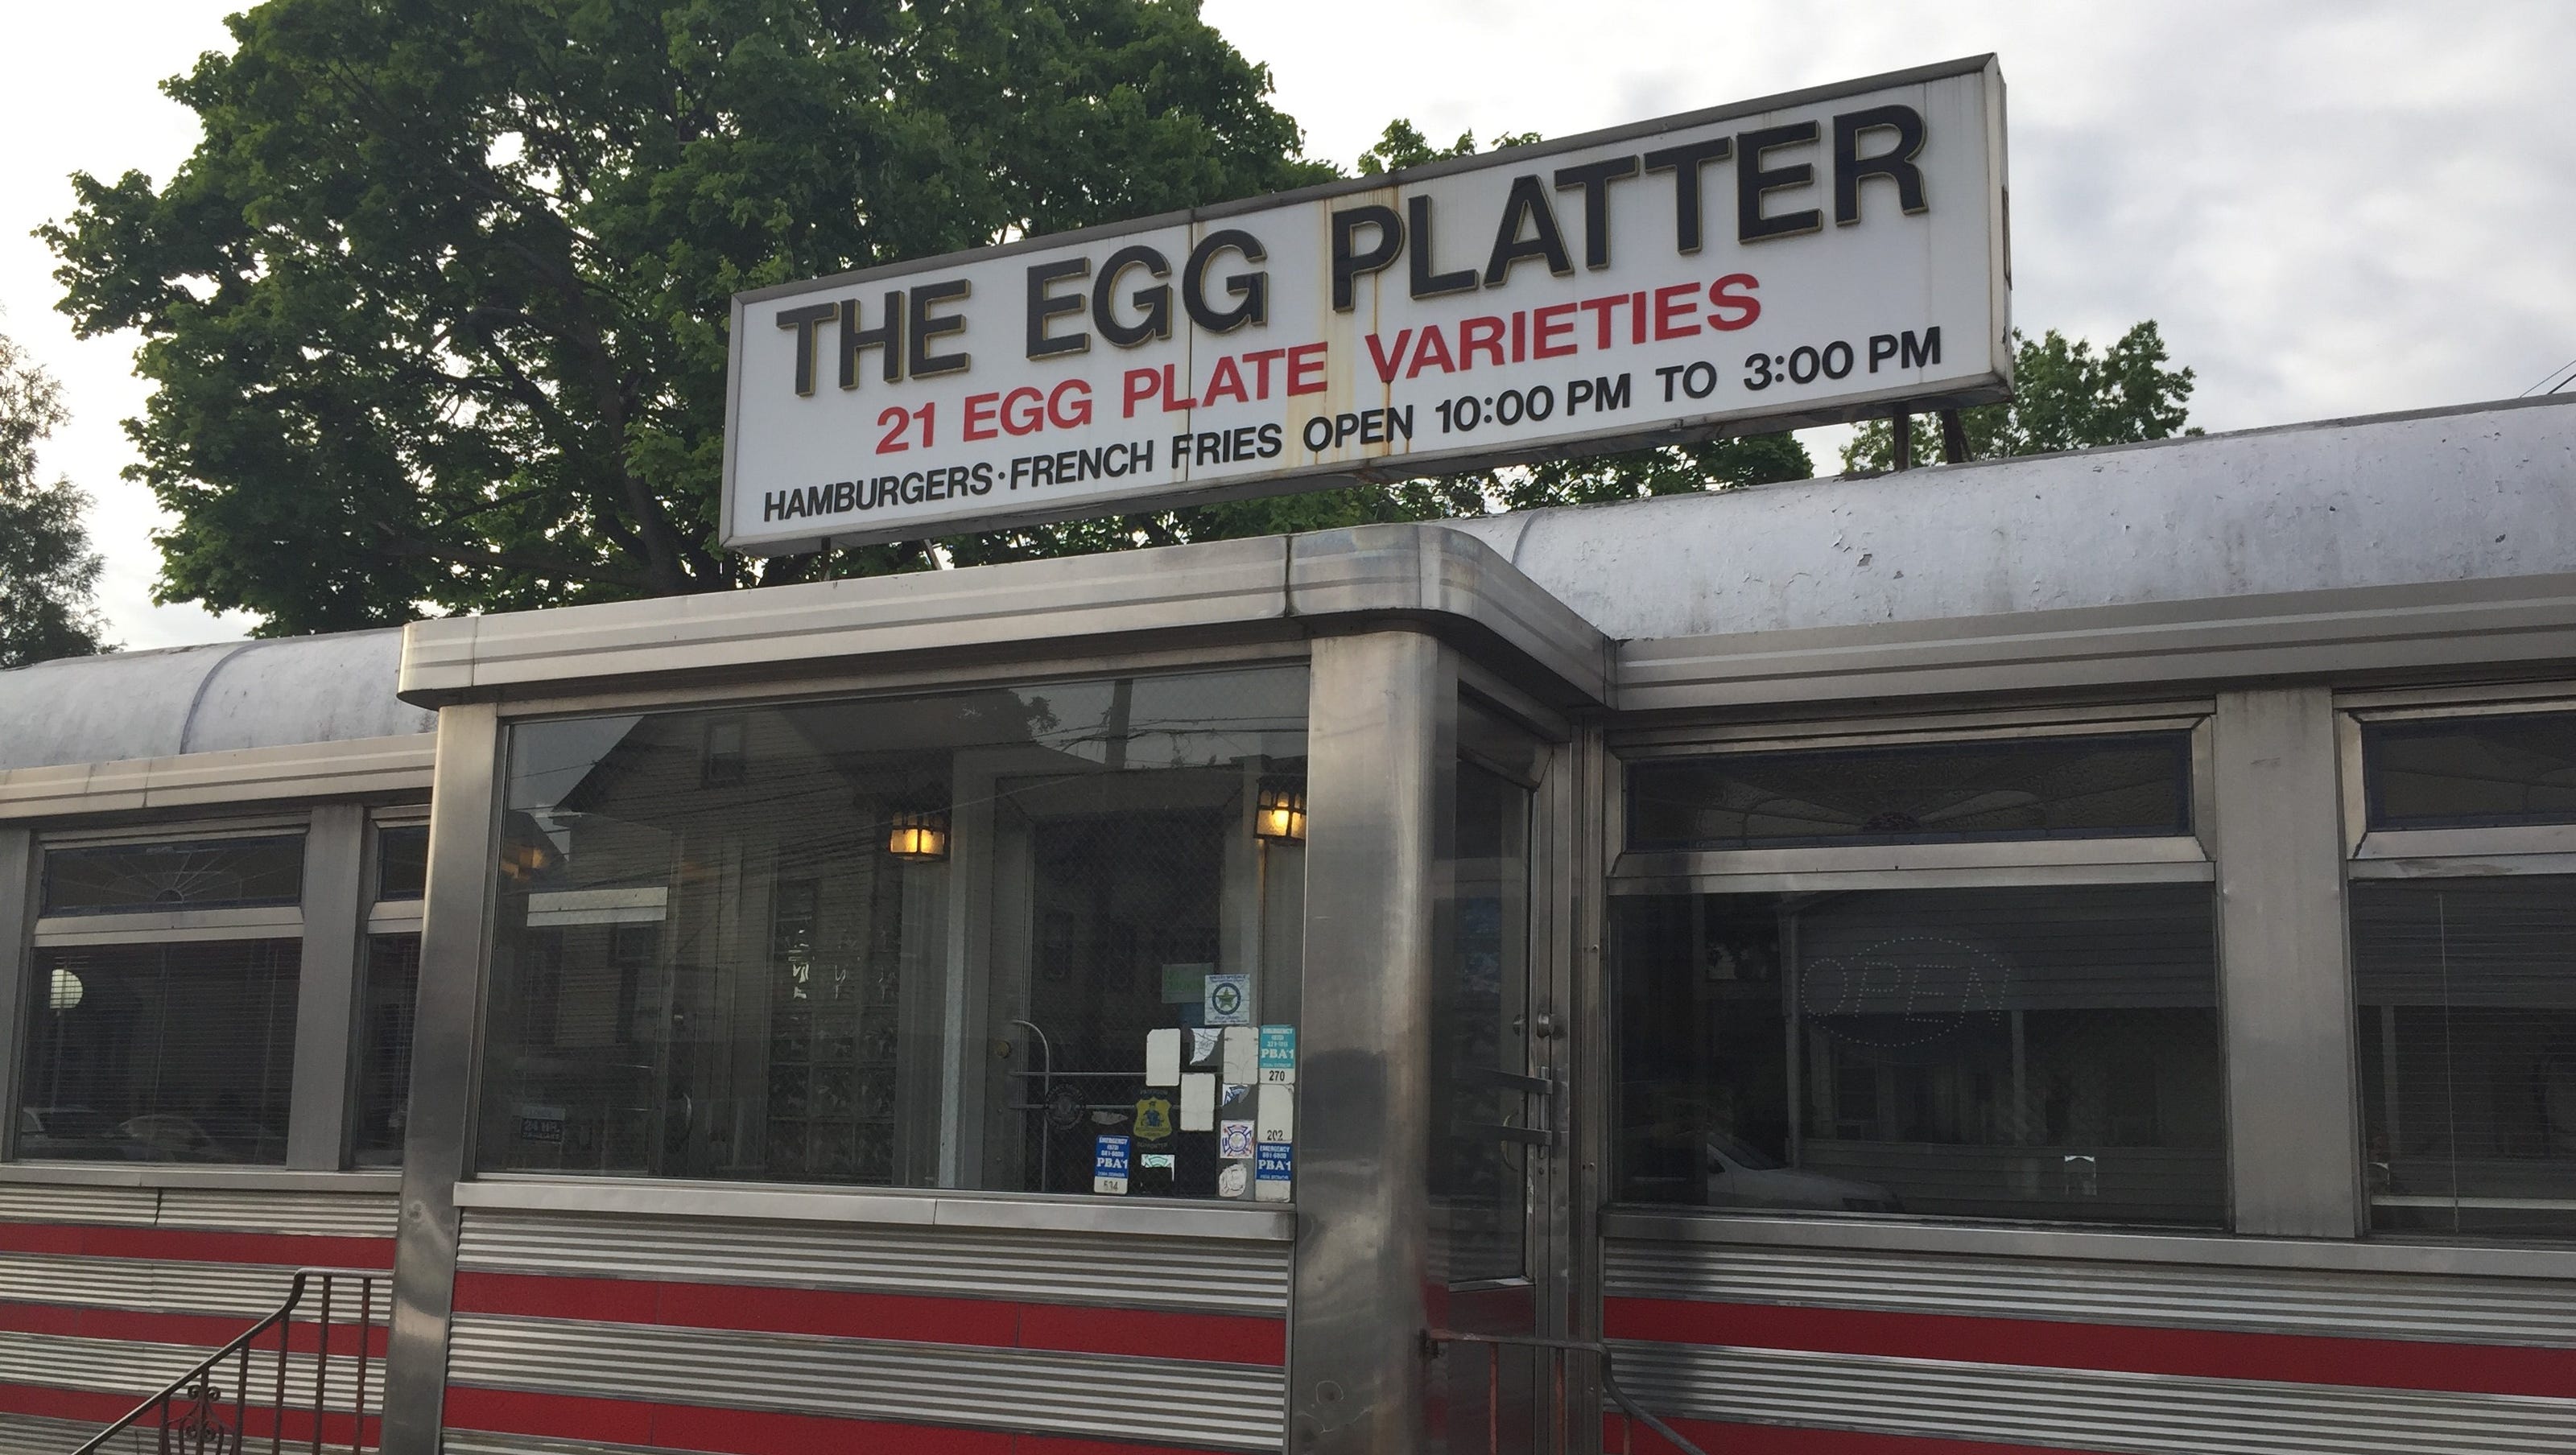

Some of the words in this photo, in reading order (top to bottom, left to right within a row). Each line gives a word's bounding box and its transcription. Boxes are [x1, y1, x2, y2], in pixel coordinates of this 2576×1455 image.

[776, 278, 972, 397] THE
[1026, 229, 1269, 362] EGG
[1331, 104, 1930, 314] PLATTER
[876, 403, 935, 455] 21
[963, 379, 1092, 441] EGG
[1124, 343, 1327, 418] PLATE
[1365, 274, 1761, 382] VARIETIES
[1171, 423, 1283, 470] FRIES
[1302, 404, 1414, 454] OPEN
[1435, 385, 1555, 434] 10:00
[1567, 373, 1632, 416] PM
[1656, 361, 1718, 403] TO
[1744, 341, 1855, 391] 3:00
[1869, 326, 1942, 373] PM
[1802, 958, 2009, 1026] OPEN
[1269, 1070, 1286, 1081] 270
